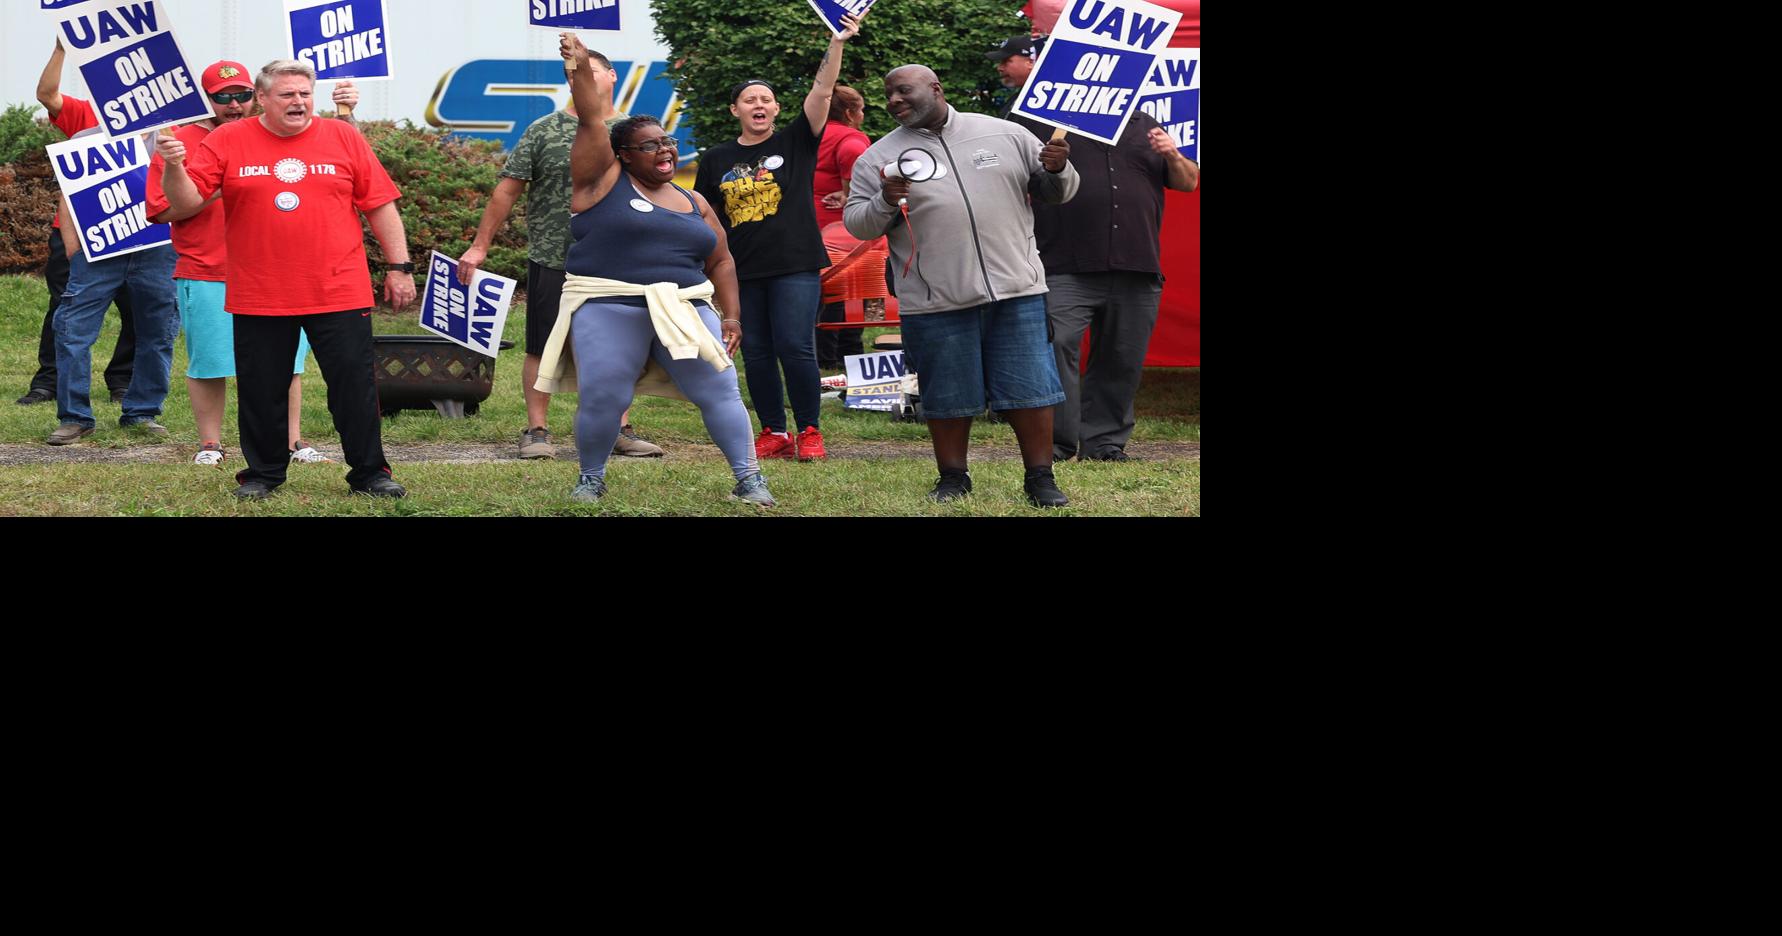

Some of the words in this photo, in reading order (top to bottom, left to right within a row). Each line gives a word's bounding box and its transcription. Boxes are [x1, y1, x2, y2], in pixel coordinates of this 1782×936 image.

[60, 1, 158, 49] UAW
[320, 4, 354, 38] ON
[533, 0, 615, 20] STR
[1069, 0, 1169, 50] UAW
[114, 47, 155, 86] ON
[298, 27, 383, 72] STRIKE
[1072, 52, 1120, 82] ON
[1148, 60, 1197, 87] AW
[103, 66, 194, 130] STRIKE
[1027, 81, 1133, 116] STRIKE
[56, 138, 136, 180] UAW
[239, 166, 271, 177] LOCAL
[309, 164, 336, 174] 1178
[98, 179, 132, 214] ON
[86, 201, 152, 252] STRIK
[433, 260, 449, 332] STRIKE
[449, 288, 466, 319] ON
[470, 278, 504, 349] UAW
